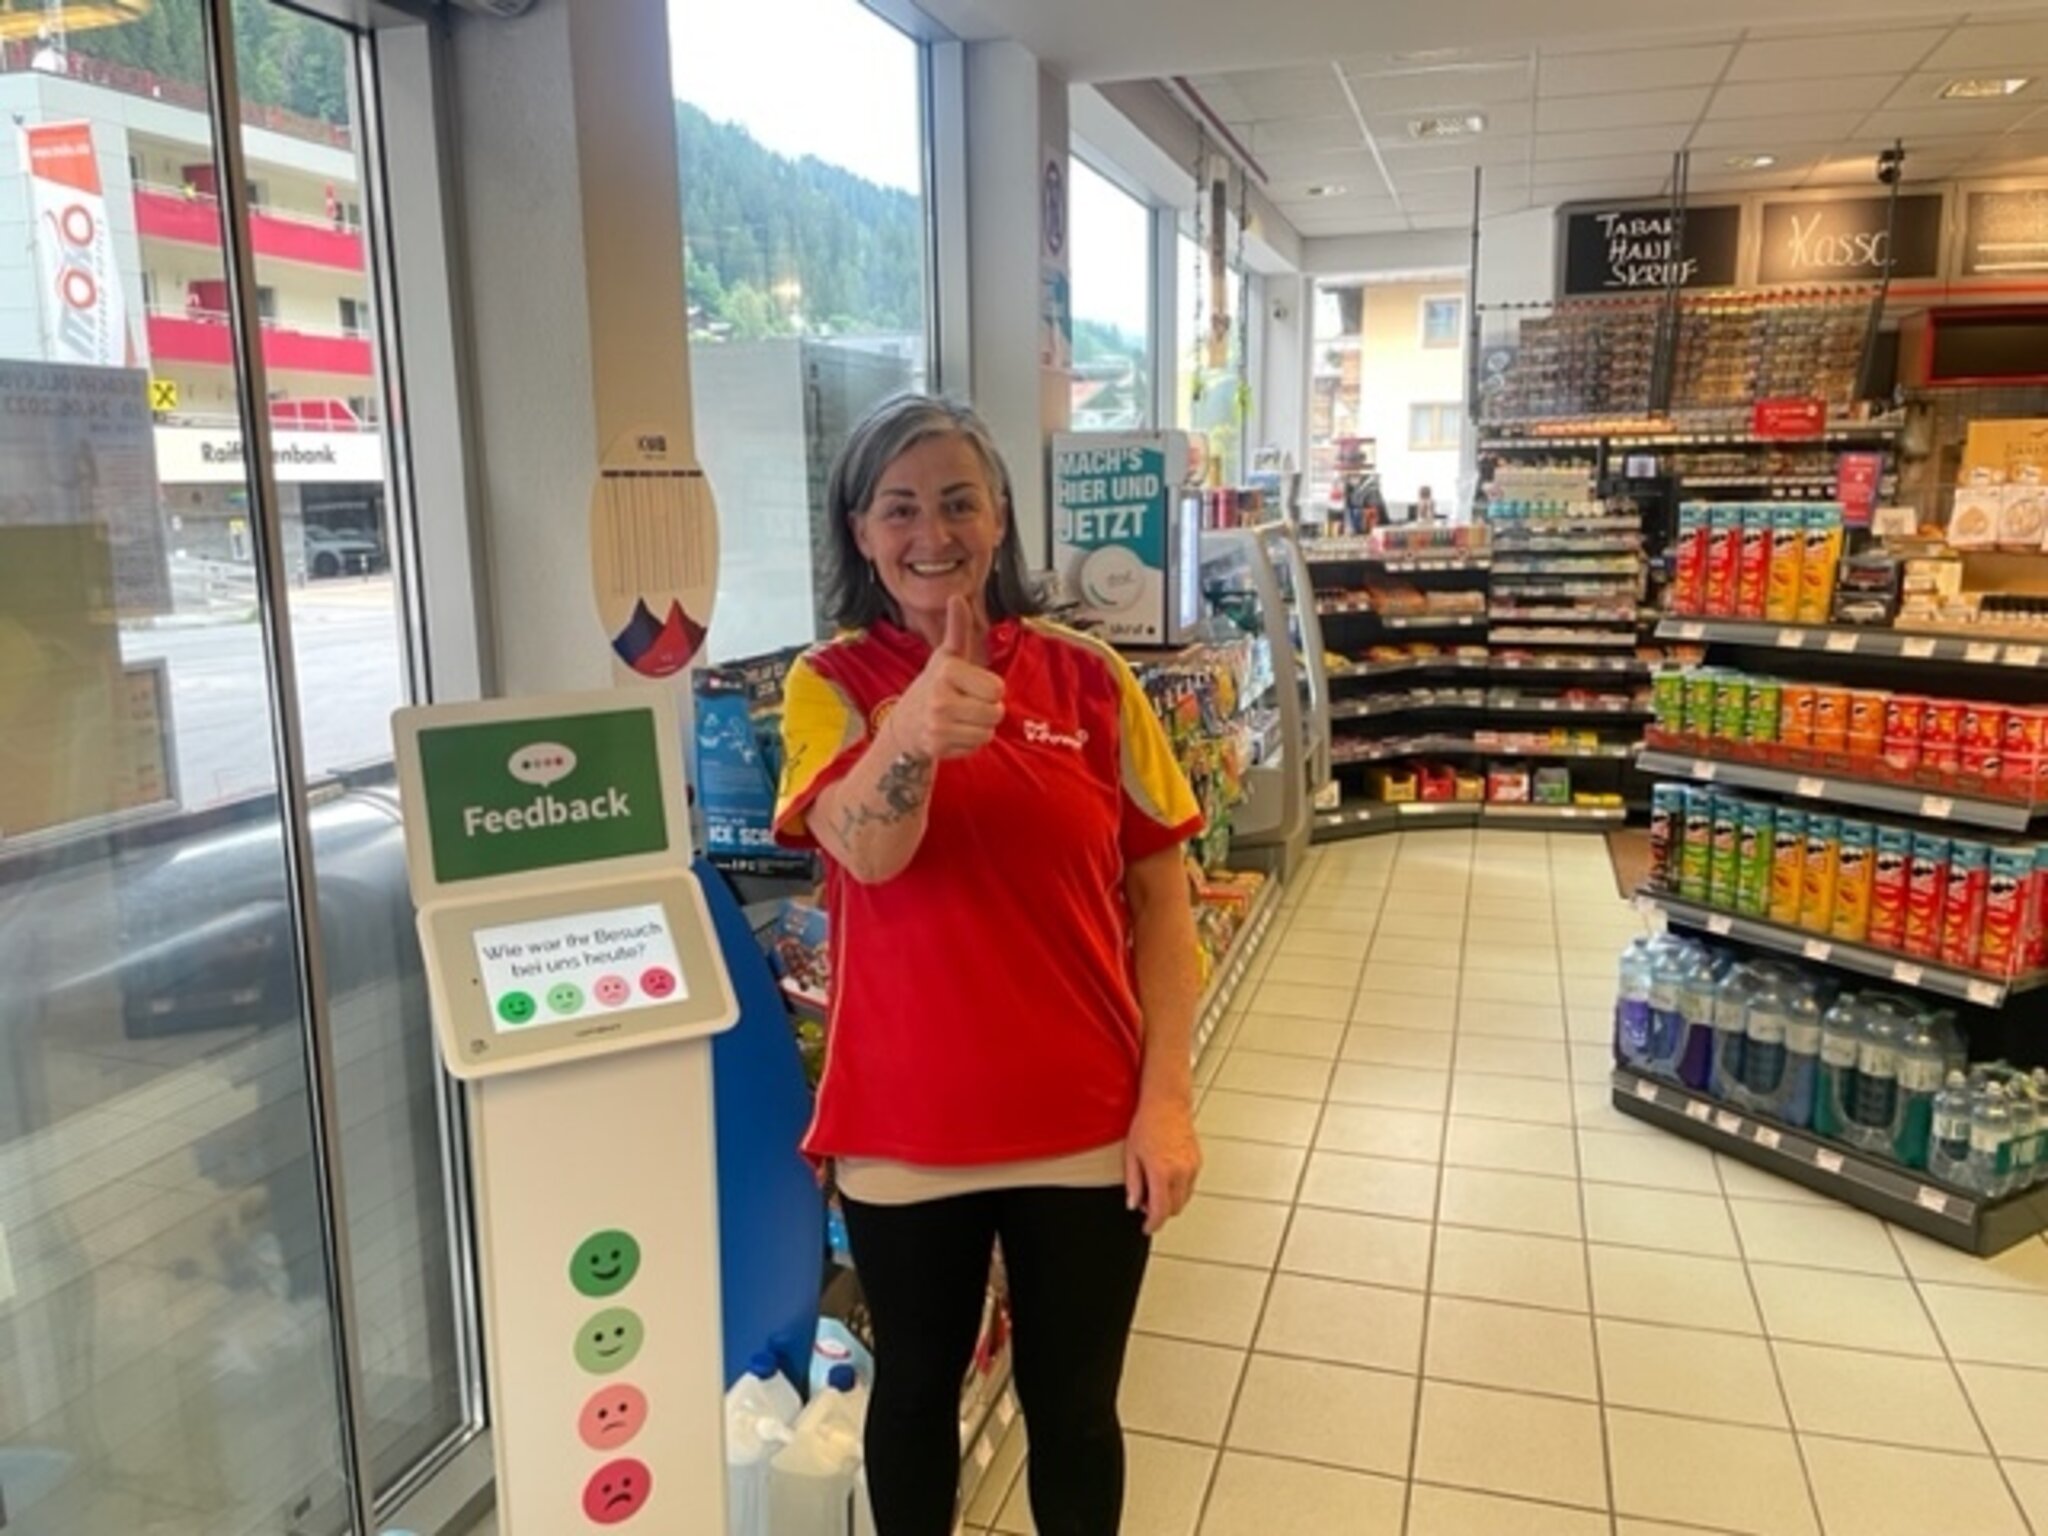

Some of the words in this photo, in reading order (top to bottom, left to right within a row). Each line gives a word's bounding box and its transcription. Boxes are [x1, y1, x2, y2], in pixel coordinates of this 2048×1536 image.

[1059, 478, 1108, 503] HIER
[1111, 473, 1160, 500] UND
[1060, 504, 1148, 542] JETZT
[464, 786, 631, 838] Feedback
[482, 944, 523, 961] Wie
[527, 938, 561, 954] war
[593, 921, 663, 944] Besuch
[510, 961, 542, 978] bei
[545, 954, 581, 973] uns
[582, 942, 648, 967] heute?
